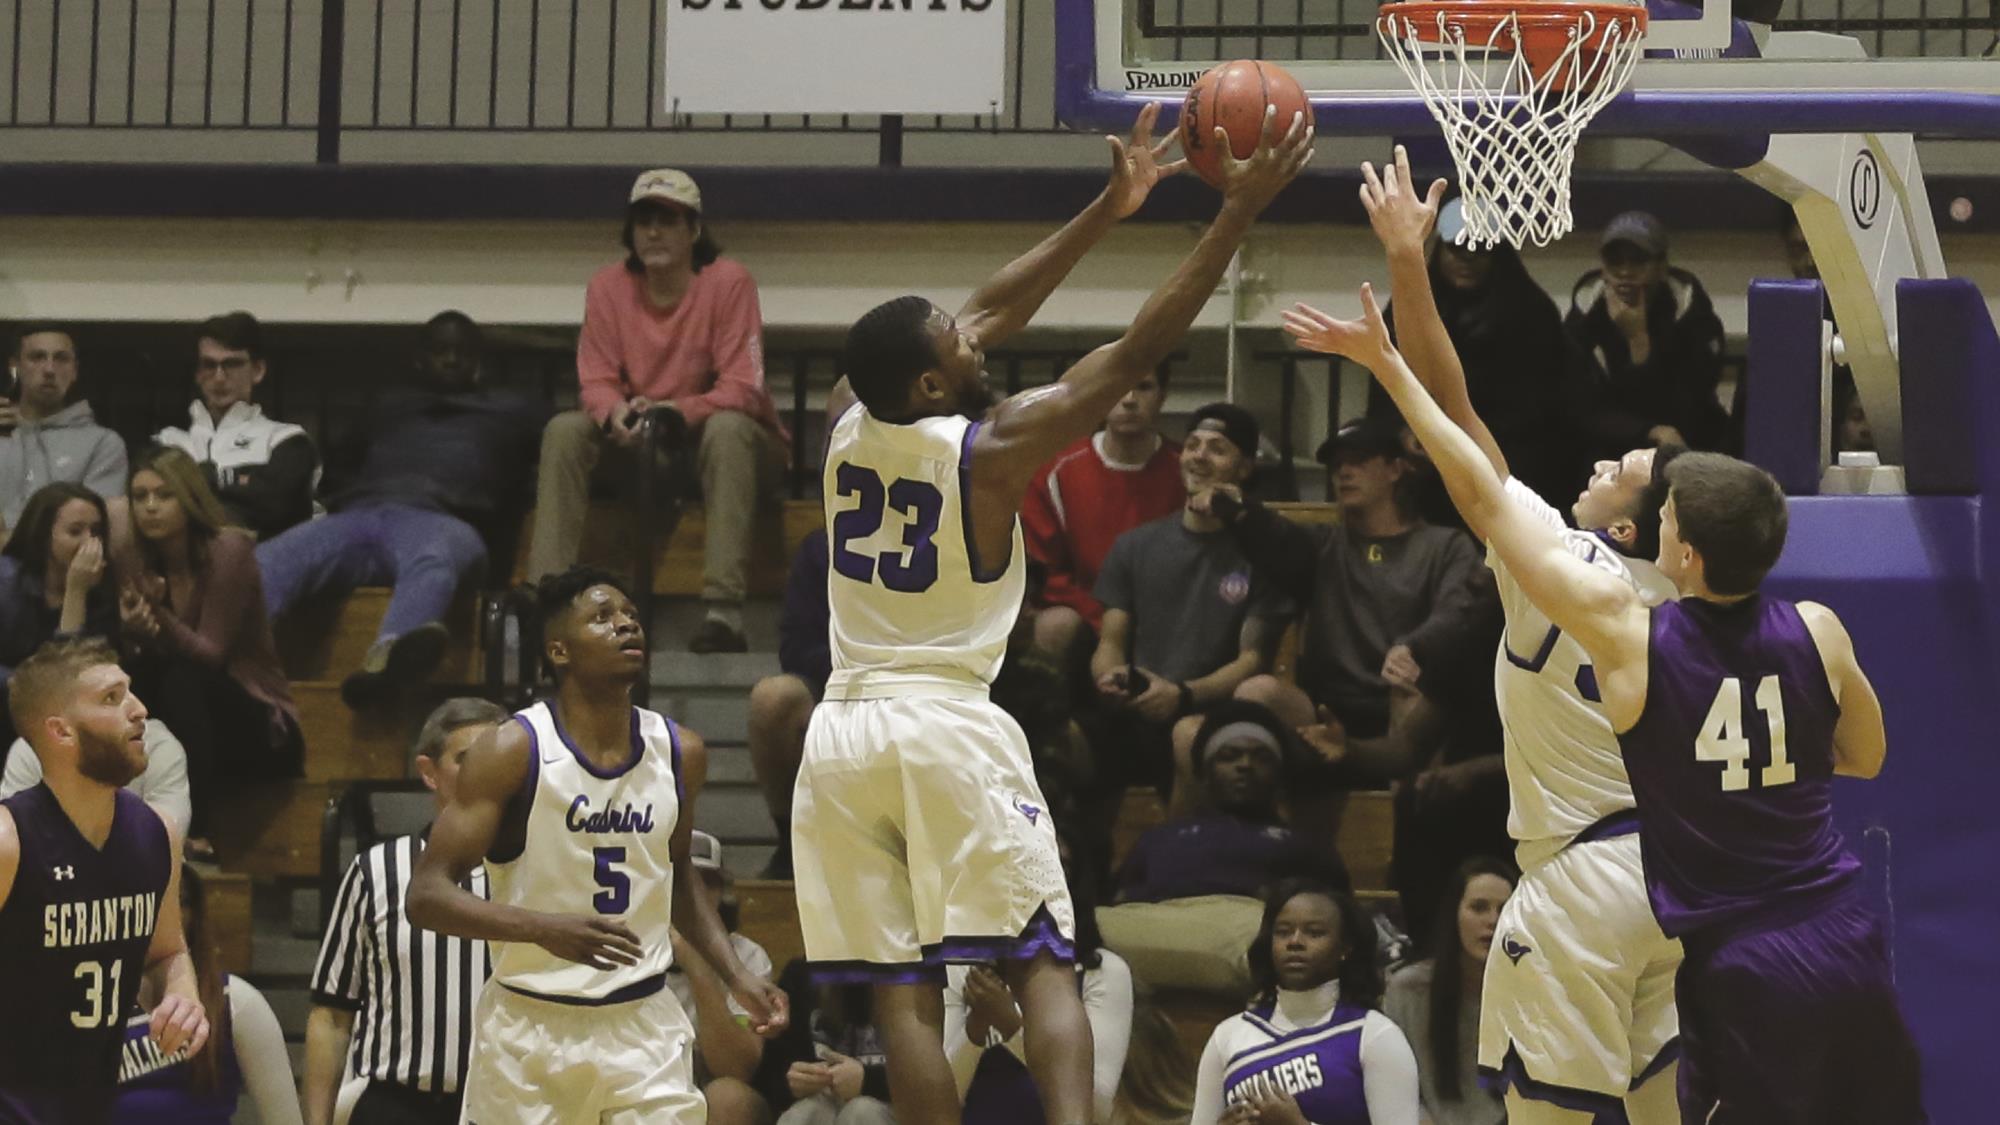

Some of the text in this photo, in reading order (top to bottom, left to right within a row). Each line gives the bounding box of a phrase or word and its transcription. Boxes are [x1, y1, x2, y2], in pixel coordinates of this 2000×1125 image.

[833, 460, 944, 593] 23
[1695, 674, 1796, 791] 41
[592, 846, 631, 914] 5
[44, 891, 156, 947] SCRANTON
[70, 959, 122, 1028] 31
